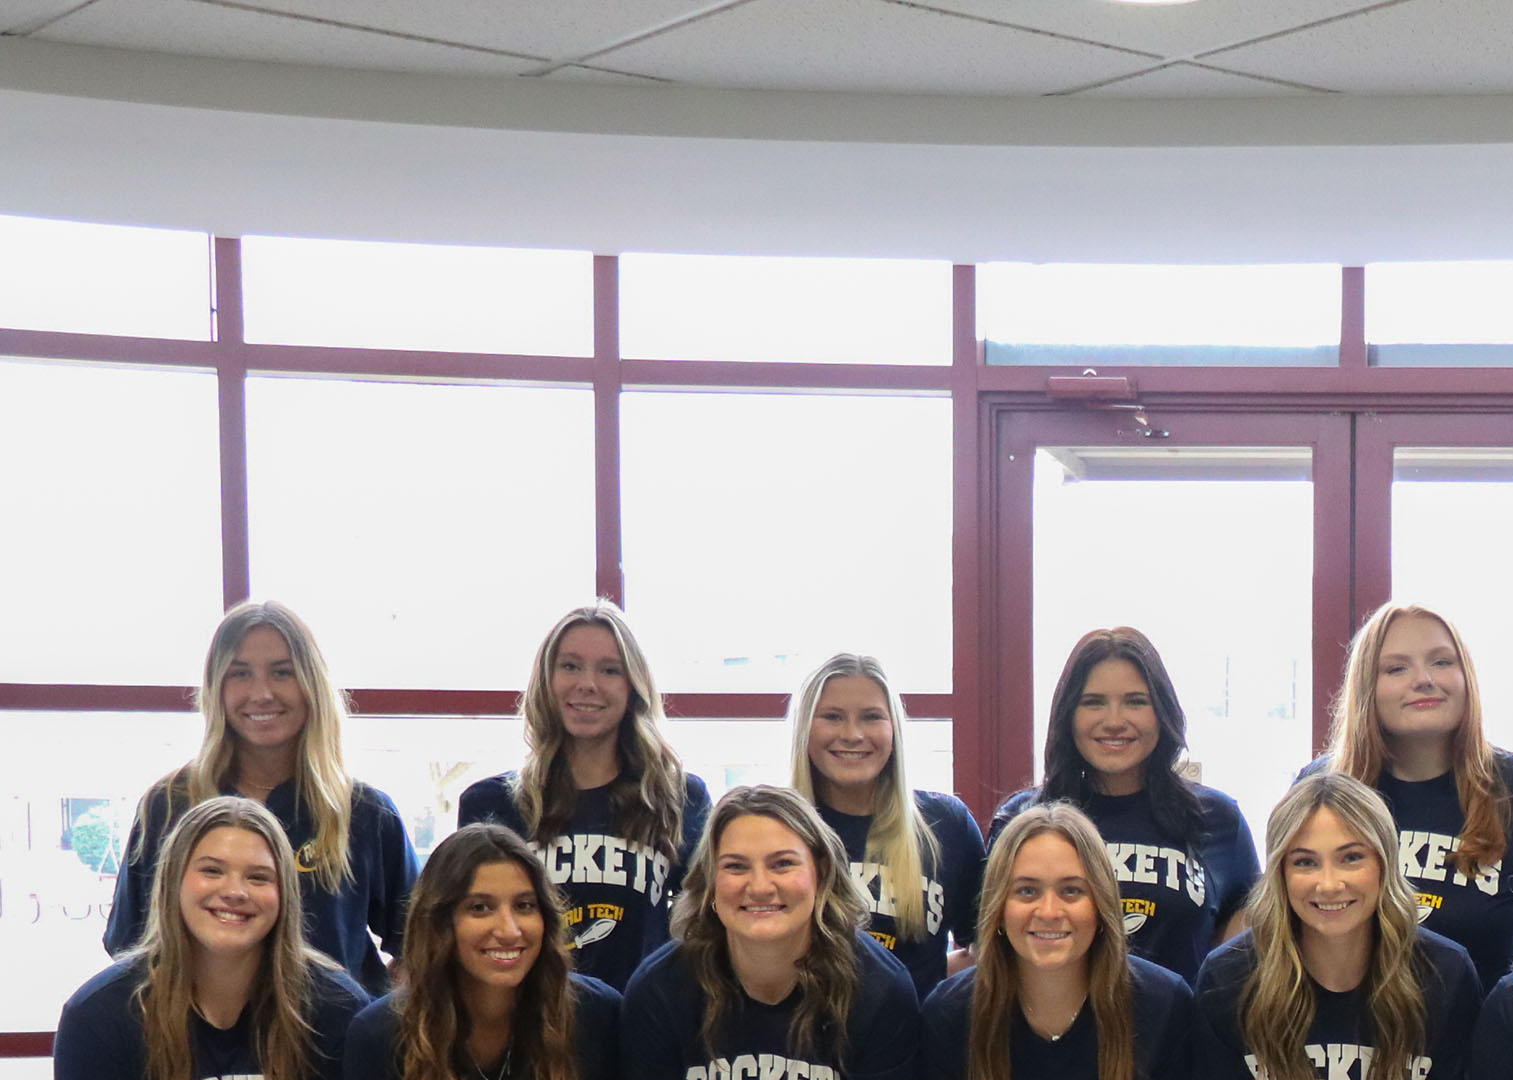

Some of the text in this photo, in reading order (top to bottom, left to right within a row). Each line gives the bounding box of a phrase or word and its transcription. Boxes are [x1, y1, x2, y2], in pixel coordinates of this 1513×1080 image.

[527, 834, 670, 907] CKETS
[1106, 843, 1206, 907] KETS
[587, 903, 624, 921] TECH
